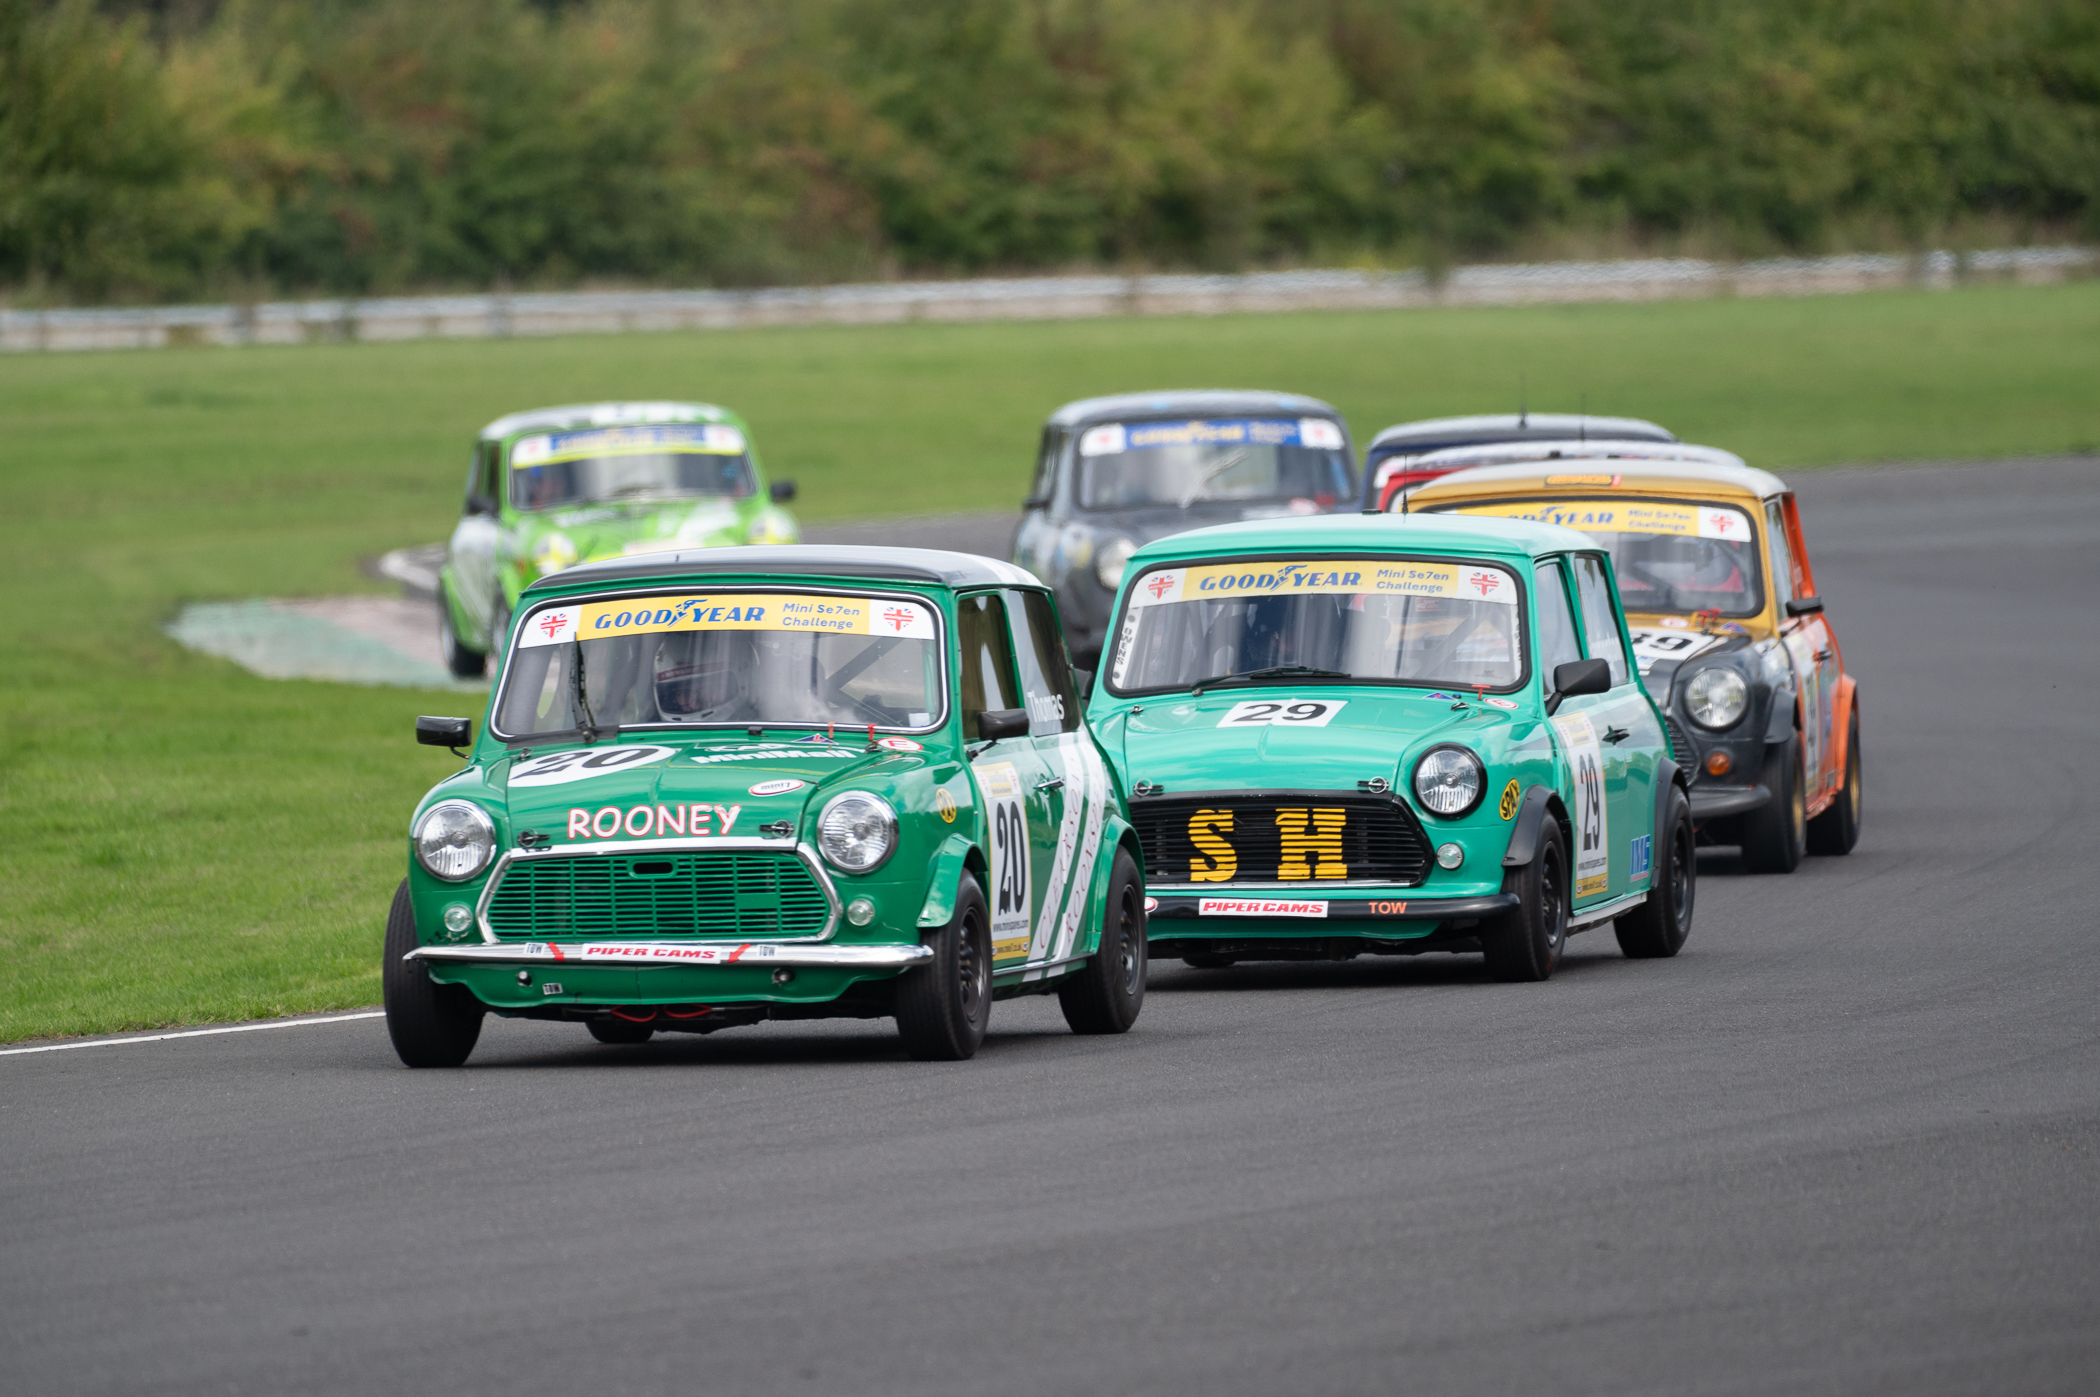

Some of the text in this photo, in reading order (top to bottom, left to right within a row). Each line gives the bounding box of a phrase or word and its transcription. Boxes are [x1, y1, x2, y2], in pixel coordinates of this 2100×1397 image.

[1200, 568, 1362, 592] GOODYEAR
[1377, 569, 1449, 580] Mini Se7en
[1376, 581, 1443, 593] Challenge
[595, 602, 766, 630] GOODYEAR
[783, 603, 860, 616] Mini Se7en
[782, 617, 854, 630] Challenge
[1116, 627, 1133, 666] OWENS
[1231, 703, 1328, 722] 29
[510, 748, 660, 780] 20
[1579, 753, 1600, 851] 29
[567, 803, 742, 840] ROONEY
[1188, 808, 1348, 881] S H
[996, 801, 1026, 917] 20
[1203, 901, 1324, 913] PIPER CAMS
[1368, 901, 1407, 914] TOW
[587, 947, 717, 959] PIPER CAMS
[759, 946, 776, 956] TOW
